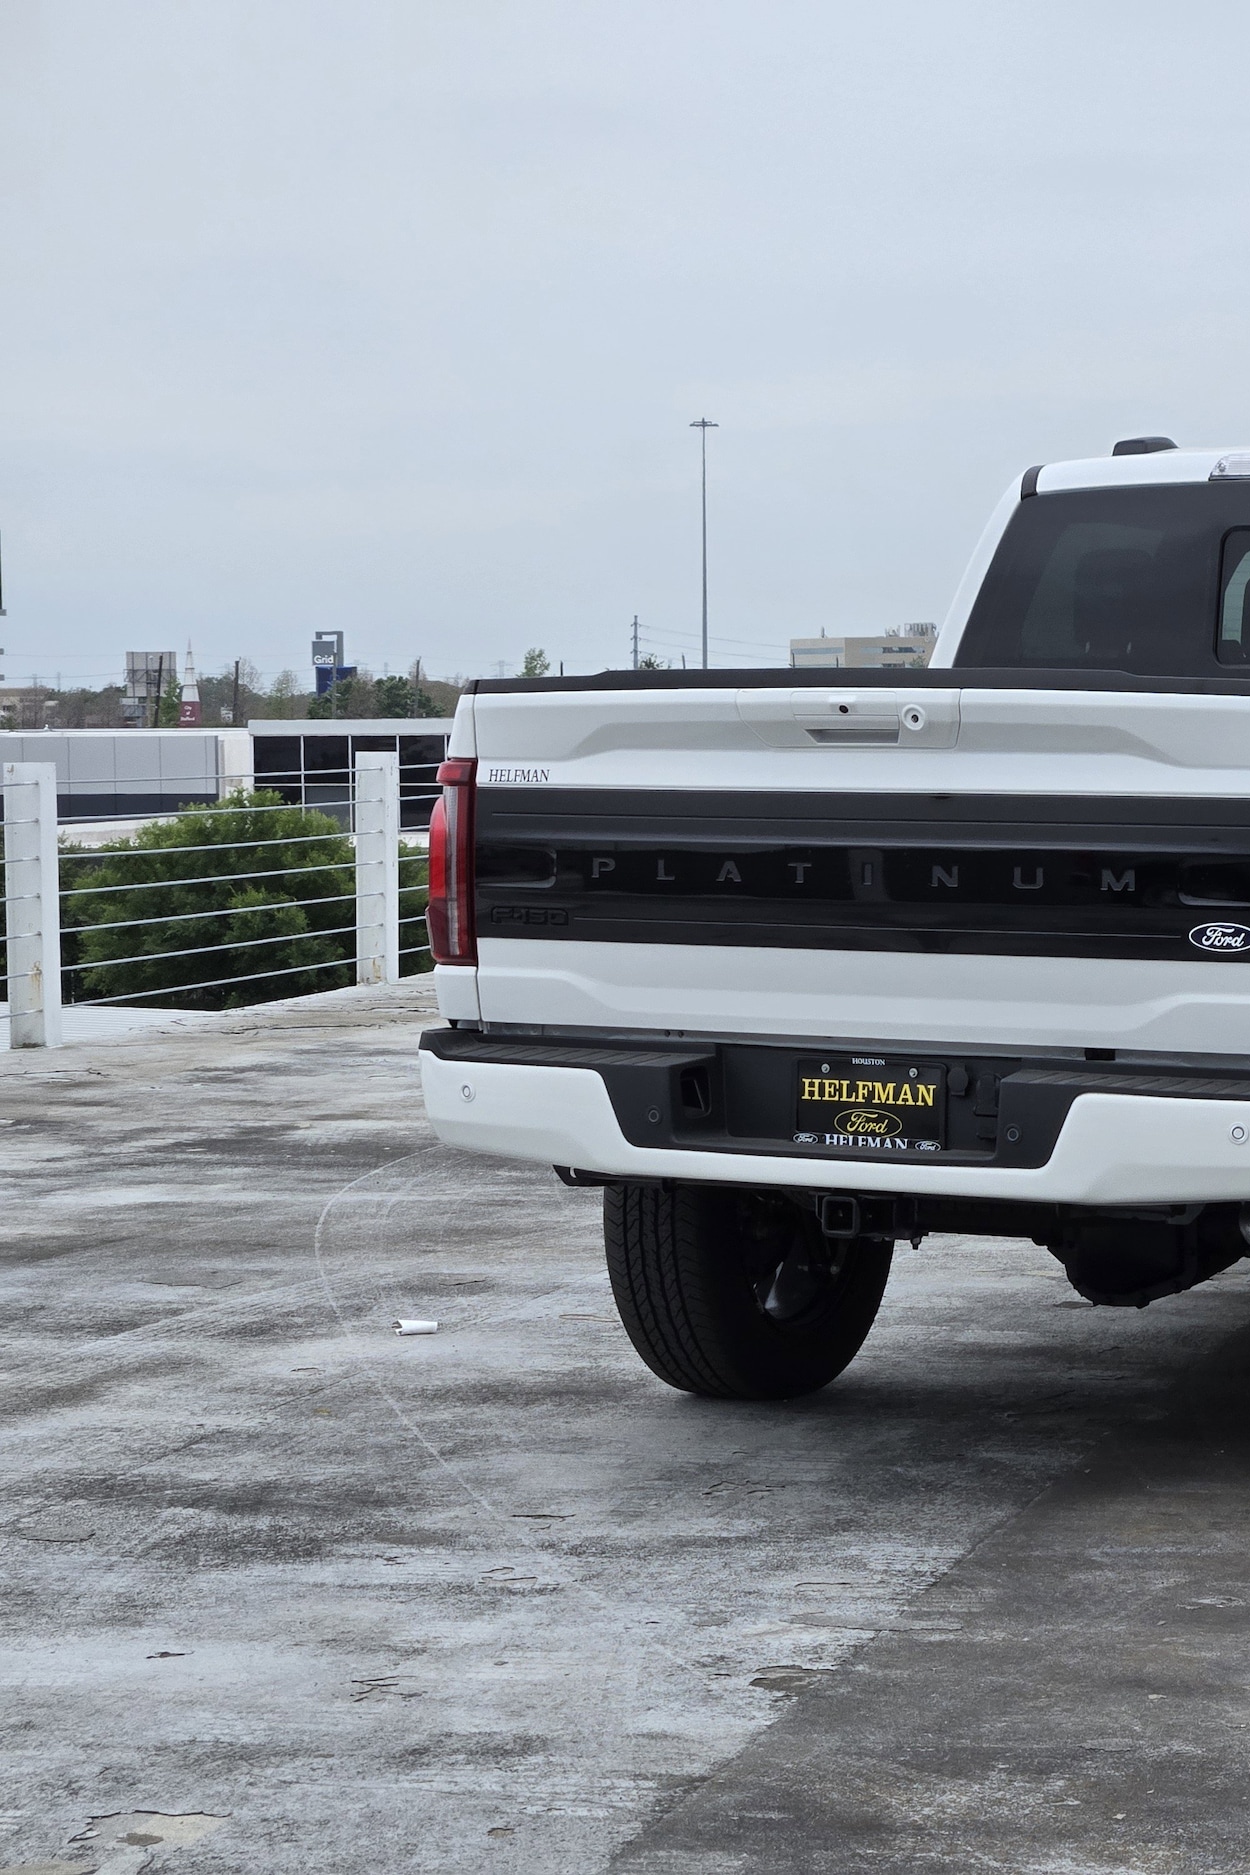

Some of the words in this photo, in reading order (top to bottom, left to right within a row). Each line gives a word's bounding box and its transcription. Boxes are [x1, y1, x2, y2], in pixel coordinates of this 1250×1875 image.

[314, 655, 334, 664] Grid
[489, 768, 550, 782] HELFMAN
[591, 857, 1136, 892] PLATINUM
[1201, 926, 1245, 947] Ford
[852, 1057, 886, 1066] HOUSTON
[802, 1078, 936, 1106] HELFMAN
[846, 1111, 889, 1133] Ford
